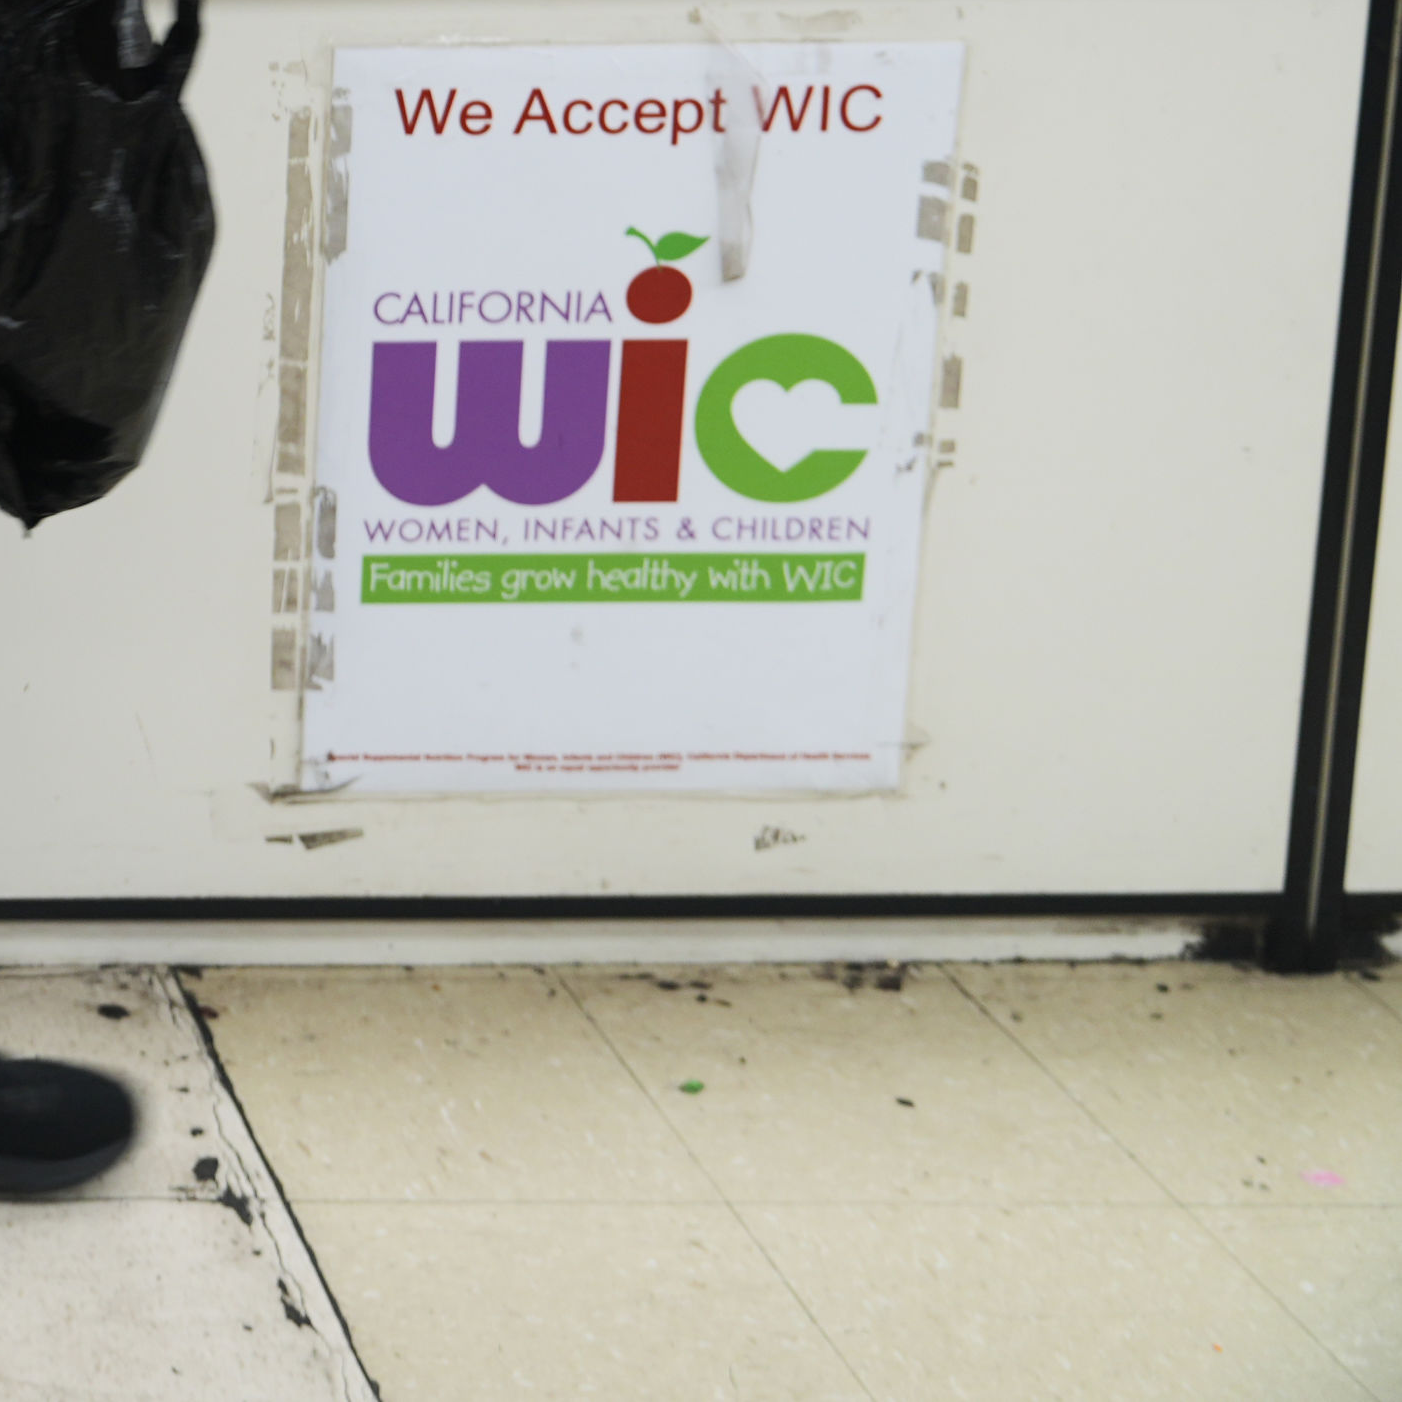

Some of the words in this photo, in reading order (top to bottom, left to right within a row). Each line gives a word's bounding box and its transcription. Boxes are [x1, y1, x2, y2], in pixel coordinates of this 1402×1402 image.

[394, 87, 493, 135] We
[513, 87, 727, 146] Accept
[752, 84, 883, 132] WIC
[373, 290, 613, 325] CALIFORNIA
[363, 517, 508, 546] WOMEN,
[524, 517, 660, 541] INFANTS
[676, 516, 696, 541] &
[711, 516, 871, 541] CHILDREN
[369, 559, 492, 593] Families
[501, 568, 577, 600] grow
[586, 557, 697, 598] healthy
[708, 559, 771, 592] with
[782, 559, 857, 593] WIC
